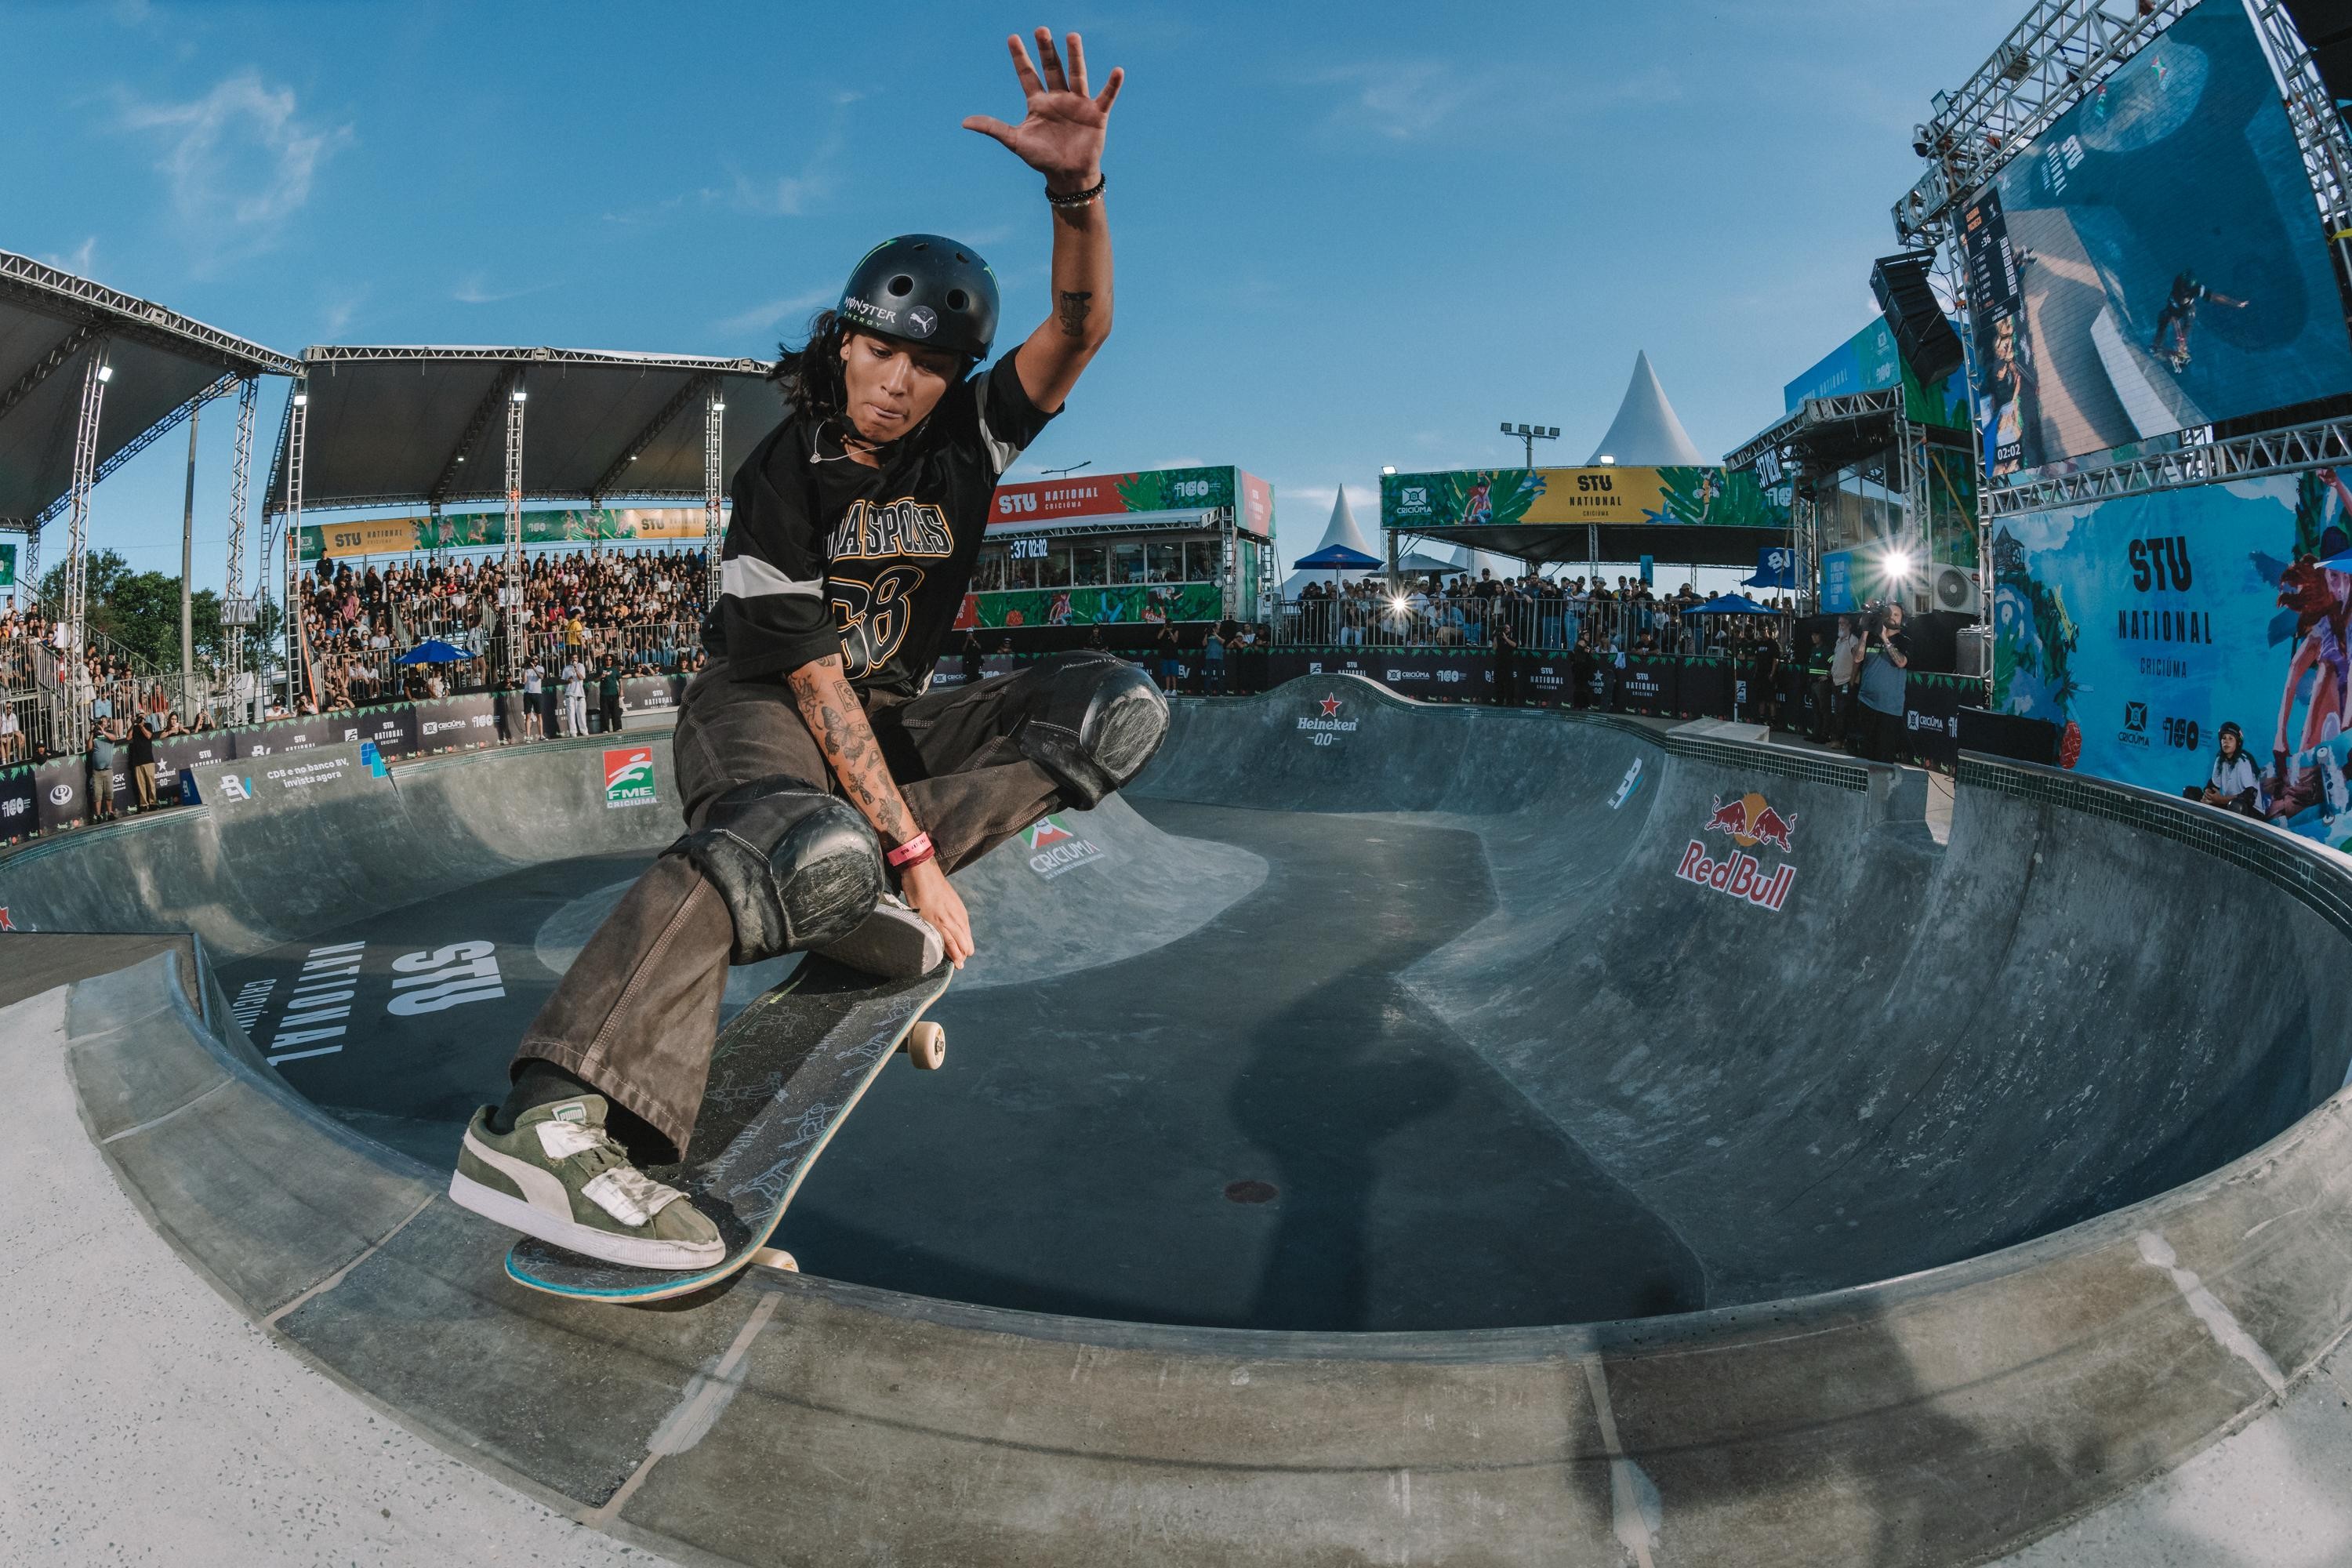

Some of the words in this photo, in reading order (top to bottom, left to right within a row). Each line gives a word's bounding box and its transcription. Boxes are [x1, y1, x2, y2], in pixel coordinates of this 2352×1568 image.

[844, 310, 883, 328] ENERGY
[1997, 443, 2021, 460] 02:02
[1577, 474, 1613, 492] STU
[999, 493, 1037, 514] STU
[1045, 486, 1098, 502] NATIONAL
[1569, 495, 1622, 506] NATIONAL
[1396, 504, 1432, 514] CRICIÚMA
[641, 518, 665, 530] STU
[335, 532, 362, 548] STU
[367, 528, 403, 539] NATIONAL
[1011, 540, 1026, 559] :37
[1028, 539, 1048, 557] 02:02
[2128, 535, 2193, 593] STU
[220, 601, 238, 623] :37
[238, 600, 256, 622] 02:02
[2118, 609, 2212, 644] NATIONAL
[2140, 656, 2187, 678] CRICIÚMA
[1530, 676, 1564, 684] NATIONAL
[1625, 681, 1659, 691] NATIONAL
[644, 696, 673, 706] NATIONAL
[383, 720, 394, 729] STU
[438, 719, 466, 730] CRICIÚMA
[1297, 717, 1356, 731] Heineken
[1919, 715, 1944, 729] CRICIÚMA
[294, 735, 306, 743] STU
[374, 728, 404, 741] NATIONAL
[2118, 731, 2150, 747] CRICIÚMA
[198, 750, 212, 760] STU
[154, 768, 176, 779] eineken
[267, 769, 285, 780] CDB
[295, 765, 307, 775] no
[307, 760, 335, 773] banco
[284, 775, 315, 788] invista
[315, 771, 342, 785] agora
[608, 786, 653, 800] FME
[1675, 839, 1741, 893] Red
[1726, 853, 1797, 912] Bull
[387, 941, 506, 1016] STU
[265, 941, 366, 1066] NATIONAL
